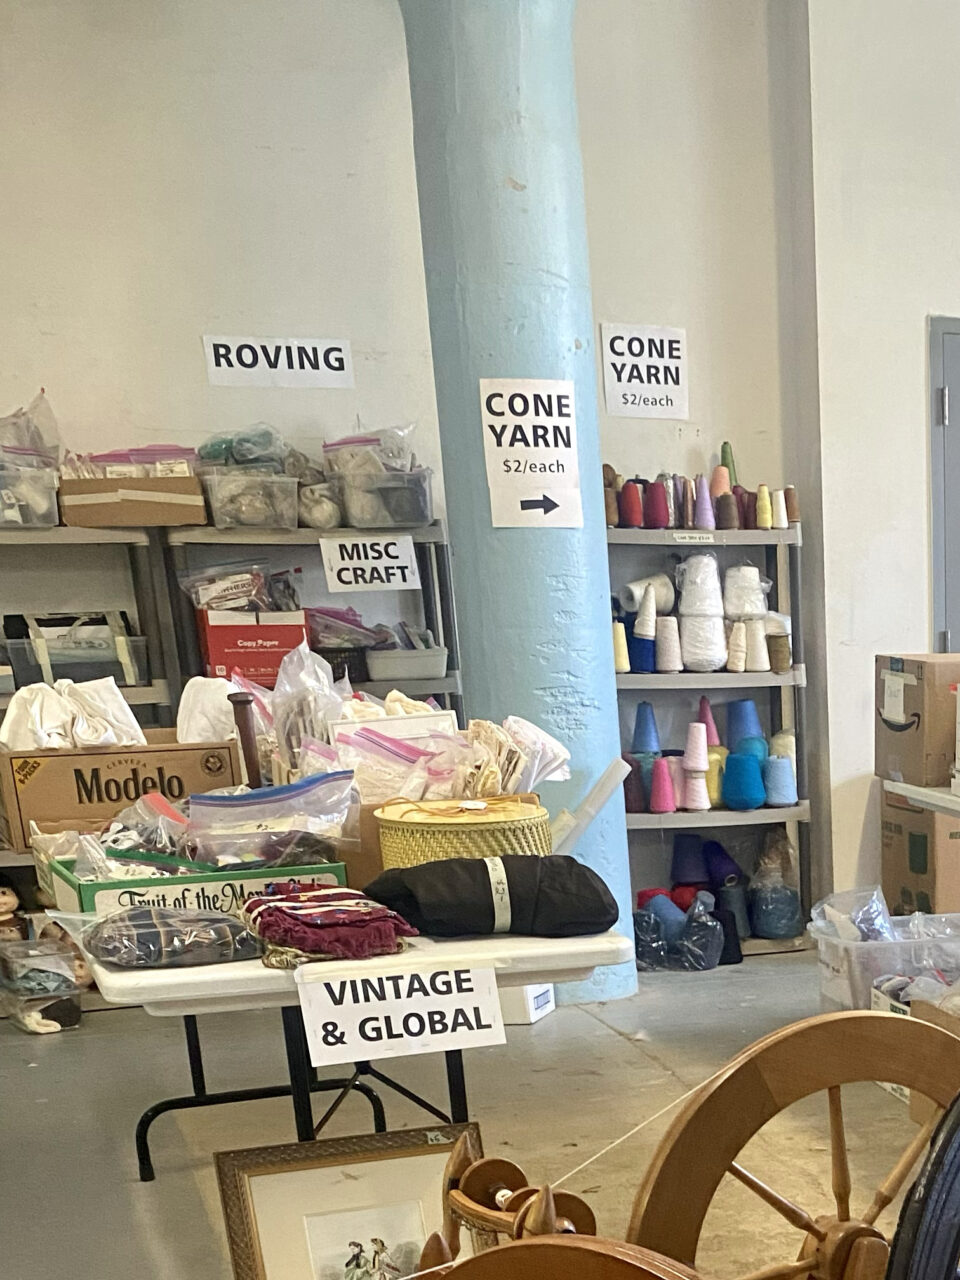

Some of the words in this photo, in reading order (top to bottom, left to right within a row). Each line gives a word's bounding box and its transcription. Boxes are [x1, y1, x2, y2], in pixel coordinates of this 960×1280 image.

[212, 343, 345, 371] ROVING
[609, 336, 681, 359] CONE
[611, 362, 680, 385] YARN
[485, 393, 571, 418] CONE
[622, 393, 674, 407] $2/each
[488, 425, 572, 448] YARN
[503, 459, 565, 473] $2/each
[338, 542, 399, 561] MISC
[336, 566, 408, 585] CRAFT
[237, 639, 256, 648] Copy
[257, 639, 279, 648] Paper
[106, 758, 147, 770] CERVEZA
[73, 766, 185, 805] Modelo
[323, 969, 474, 1006] VINTAGE
[321, 1021, 347, 1047] &
[358, 1007, 492, 1042] GLOBAL
